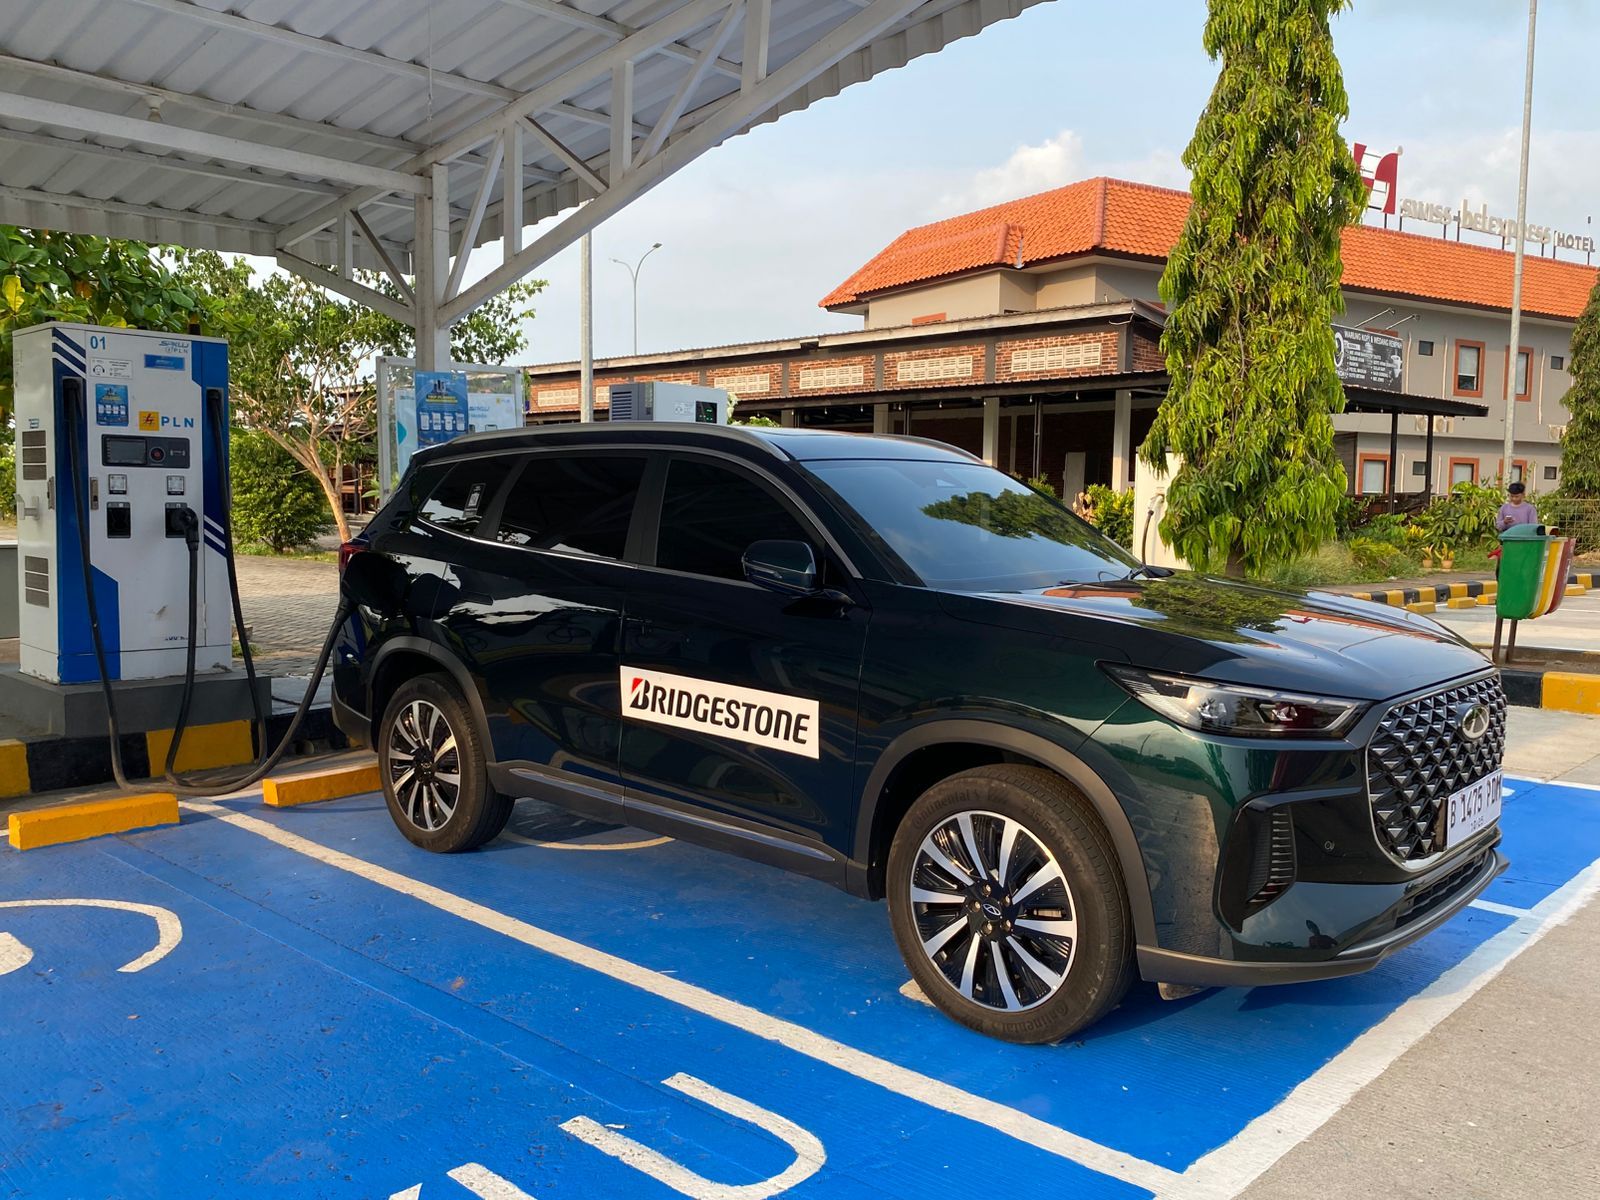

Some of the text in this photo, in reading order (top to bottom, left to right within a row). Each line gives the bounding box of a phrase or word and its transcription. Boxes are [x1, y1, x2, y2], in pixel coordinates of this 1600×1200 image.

[1557, 231, 1596, 252] HOTEL
[90, 336, 107, 350] 01
[161, 416, 194, 428] PLN
[630, 677, 810, 745] BRIDGESTONE
[1451, 801, 1457, 828] B
[1461, 785, 1482, 822] 1475
